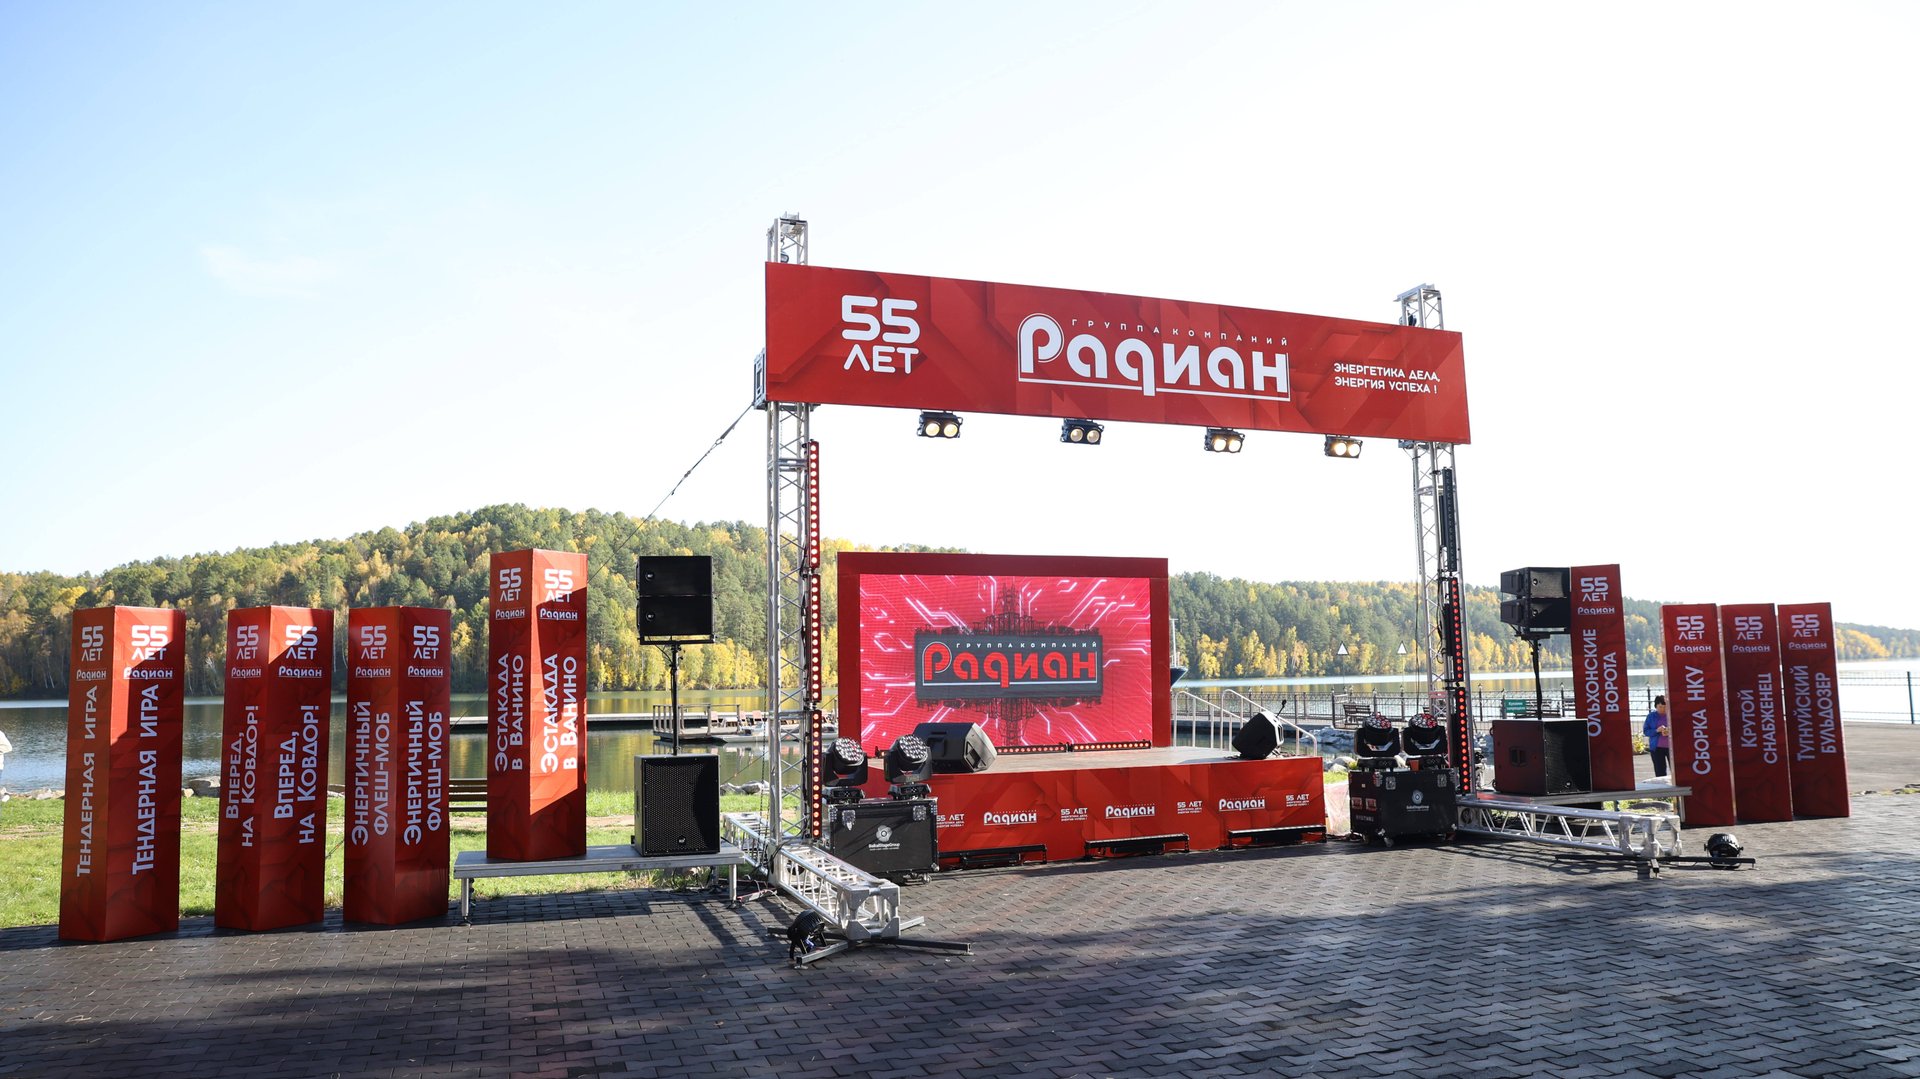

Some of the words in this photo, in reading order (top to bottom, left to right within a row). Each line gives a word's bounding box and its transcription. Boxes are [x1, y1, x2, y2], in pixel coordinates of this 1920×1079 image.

[842, 295, 920, 344] 55
[1072, 319, 1160, 334] ГРУППА
[1172, 328, 1288, 346] КОМПАНИЙ
[844, 344, 919, 374] ЛЕТ
[1018, 313, 1290, 401] Радиан
[1334, 363, 1405, 378] ЭНЕРГЕТИКА
[1409, 370, 1440, 382] ДЕЛА,
[1335, 376, 1385, 390] ЭНЕРГИЯ
[1389, 381, 1431, 393] УСПЕХА
[499, 567, 522, 589] 55
[544, 568, 573, 589] 55
[1580, 577, 1608, 593] 55
[500, 589, 521, 602] ЛЕТ
[545, 590, 572, 603] ЛЕТ
[1582, 592, 1608, 602] ЛЕТ
[495, 609, 525, 620] Радиан
[540, 608, 578, 620] Радиан
[1577, 607, 1615, 615] Радиан
[1791, 614, 1820, 628] 55
[1676, 615, 1705, 631] 55
[1734, 616, 1763, 631] 55
[1793, 628, 1820, 637] ЛЕТ
[81, 625, 104, 648] 55
[131, 625, 168, 647] 55
[236, 625, 259, 646] 55
[285, 625, 317, 646] 55
[361, 625, 387, 646] 55
[413, 625, 440, 646] 55
[1678, 630, 1705, 640] ЛЕТ
[1736, 630, 1763, 640] ЛЕТ
[81, 648, 103, 662] ЛЕТ
[131, 647, 167, 660] ЛЕТ
[236, 647, 258, 660] ЛЕТ
[286, 647, 317, 660] ЛЕТ
[361, 646, 386, 659] ЛЕТ
[413, 647, 439, 659] ЛЕТ
[1674, 645, 1712, 653] Радиан
[76, 669, 107, 681] Радиан
[123, 667, 173, 680] Радиан
[231, 667, 261, 679] Радиан
[278, 665, 322, 678] Радиан
[355, 666, 391, 678] Радиан
[408, 665, 443, 678] Радиан
[922, 641, 1097, 688] Радиан
[1583, 629, 1602, 737] ОЛЬХОНСКИЕ
[1603, 652, 1620, 713] ВОРОТА
[1685, 665, 1705, 701] НКУ
[140, 684, 159, 737] ИГРА
[510, 655, 524, 745] ВАНИНО
[560, 656, 577, 746] ВАНИНО
[84, 685, 97, 739] ИГРА
[495, 653, 509, 771] ЭСТАКАДА
[541, 653, 558, 773] ЭСТАКАДА
[1737, 689, 1758, 748] КРУТОЙ
[1758, 672, 1778, 765] СНАБЖЕНЕЦ
[1789, 665, 1815, 761] ТУГНУЙСКИЙ
[1815, 672, 1837, 754] БУЛЬДОЗЕР
[1692, 709, 1711, 775] СБОРКА
[241, 705, 259, 804] КОВДОР!
[297, 705, 319, 801] КОВДОР!
[225, 732, 245, 819] ВПЕРЕД,
[273, 731, 300, 819] ВПЕРЕД,
[351, 701, 371, 845] ЭНЕРГИЧНЫЙ
[374, 712, 390, 836] ФЛЕШ-МОБ
[404, 701, 423, 845] ЭНЕРГИЧНЫЙ
[427, 711, 442, 831] ФЛЕШ-МОБ
[77, 753, 95, 877] ТЕНДЕРНАЯ
[132, 750, 157, 875] ТЕНДЕРНАЯ
[1105, 805, 1155, 819] Радиан
[1218, 798, 1265, 812] Радиан
[984, 812, 1037, 825] Радиан
